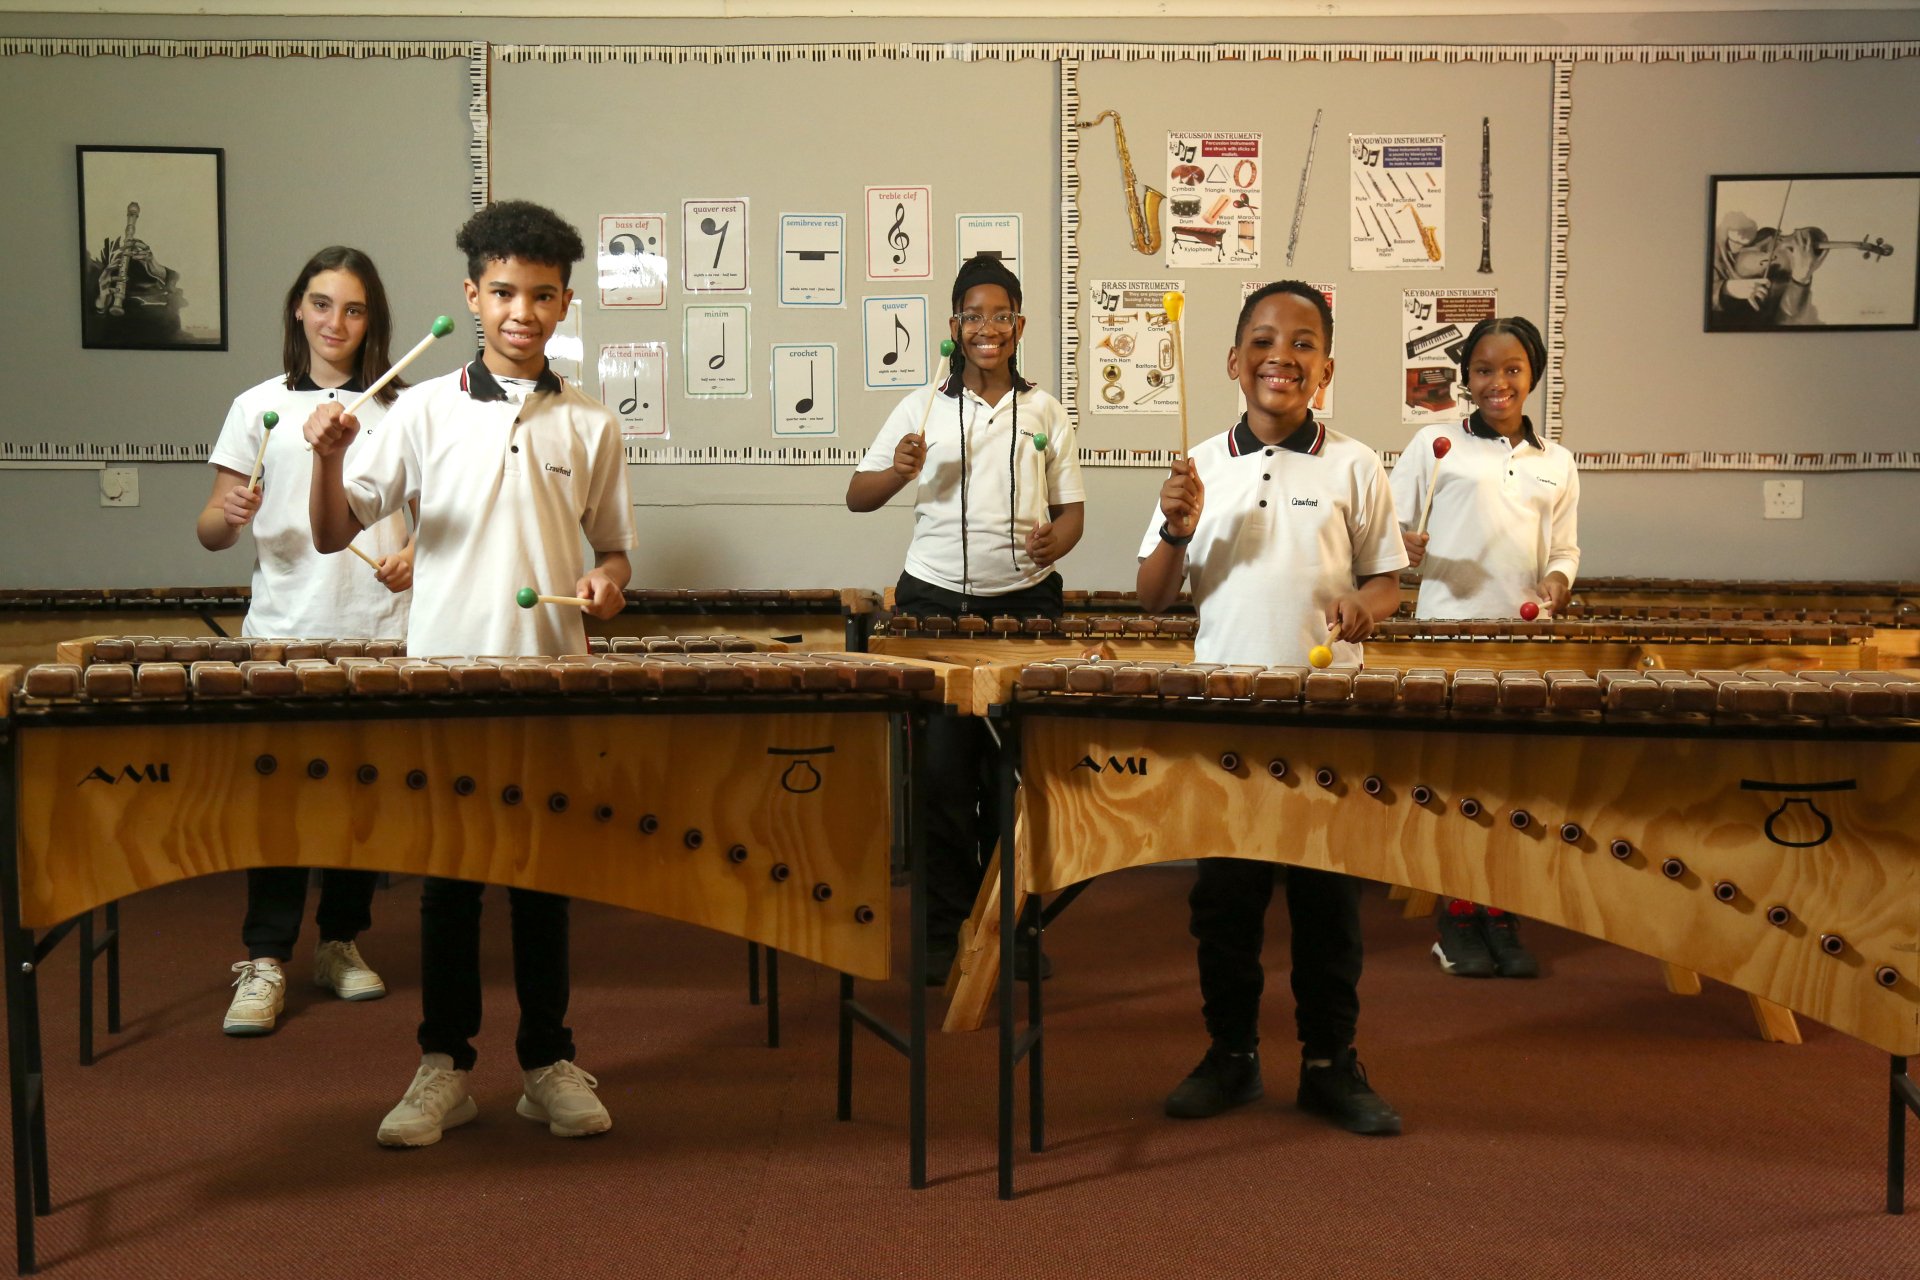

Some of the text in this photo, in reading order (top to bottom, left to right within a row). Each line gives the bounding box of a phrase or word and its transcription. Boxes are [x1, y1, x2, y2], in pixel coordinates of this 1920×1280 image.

[1170, 132, 1261, 140] PERCUSSION INSTRUMENTS
[1354, 136, 1444, 144] WOODWIND INSTRUMENTS
[879, 191, 917, 201] treble clef
[693, 205, 737, 214] quaver rest
[635, 221, 649, 231] clef
[786, 219, 839, 227] semibreve rest
[1102, 282, 1179, 290] BRASS INSTRUMENTS
[1405, 289, 1496, 297] KEYBOARD INSTRUMENTS
[882, 302, 909, 310] quaver
[789, 350, 818, 358] crochet
[545, 463, 571, 477] Crawford
[1292, 497, 1318, 507] Crawford
[1070, 755, 1147, 776] AMI
[77, 763, 170, 787] AMI
